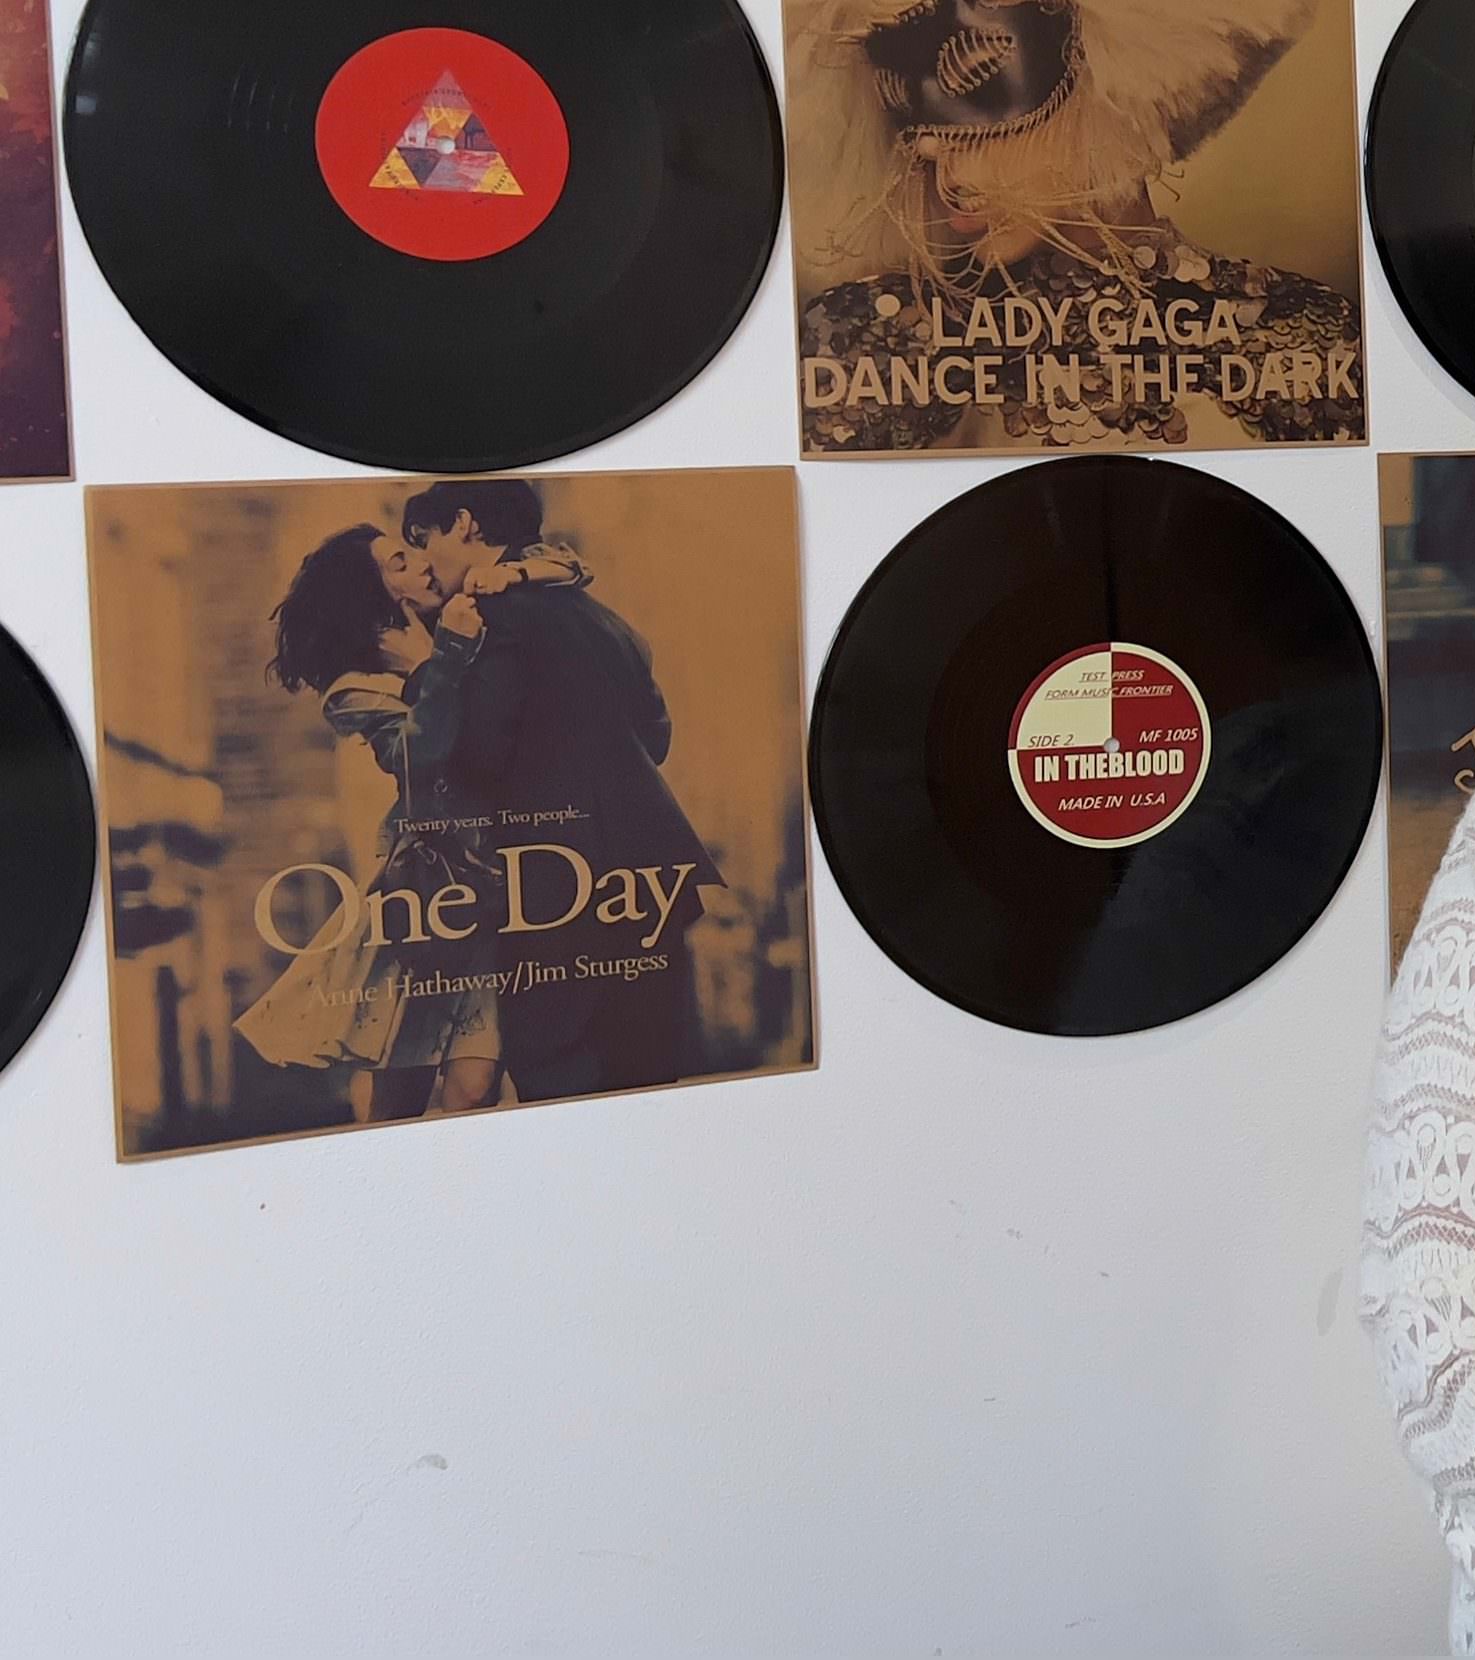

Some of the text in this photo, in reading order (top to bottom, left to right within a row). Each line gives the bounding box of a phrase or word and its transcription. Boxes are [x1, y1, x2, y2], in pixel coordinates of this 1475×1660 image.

[931, 296, 1240, 348] LADY GAGA
[802, 351, 1360, 409] DANCE IN THE DARK
[1080, 669, 1145, 682] TEST PRESS
[1045, 688, 1080, 699] FORM
[1119, 684, 1174, 697] FRONTIER
[1027, 734, 1060, 749] SIDE
[1139, 730, 1162, 744] MF
[1164, 727, 1199, 742] 1005
[1033, 749, 1185, 783] IN THEBLOOD
[1057, 791, 1167, 812] MADE IN U.S.A
[393, 804, 591, 835] Twenty years. Two people...
[253, 841, 697, 956] One Day
[574, 953, 669, 983] Sturgess
